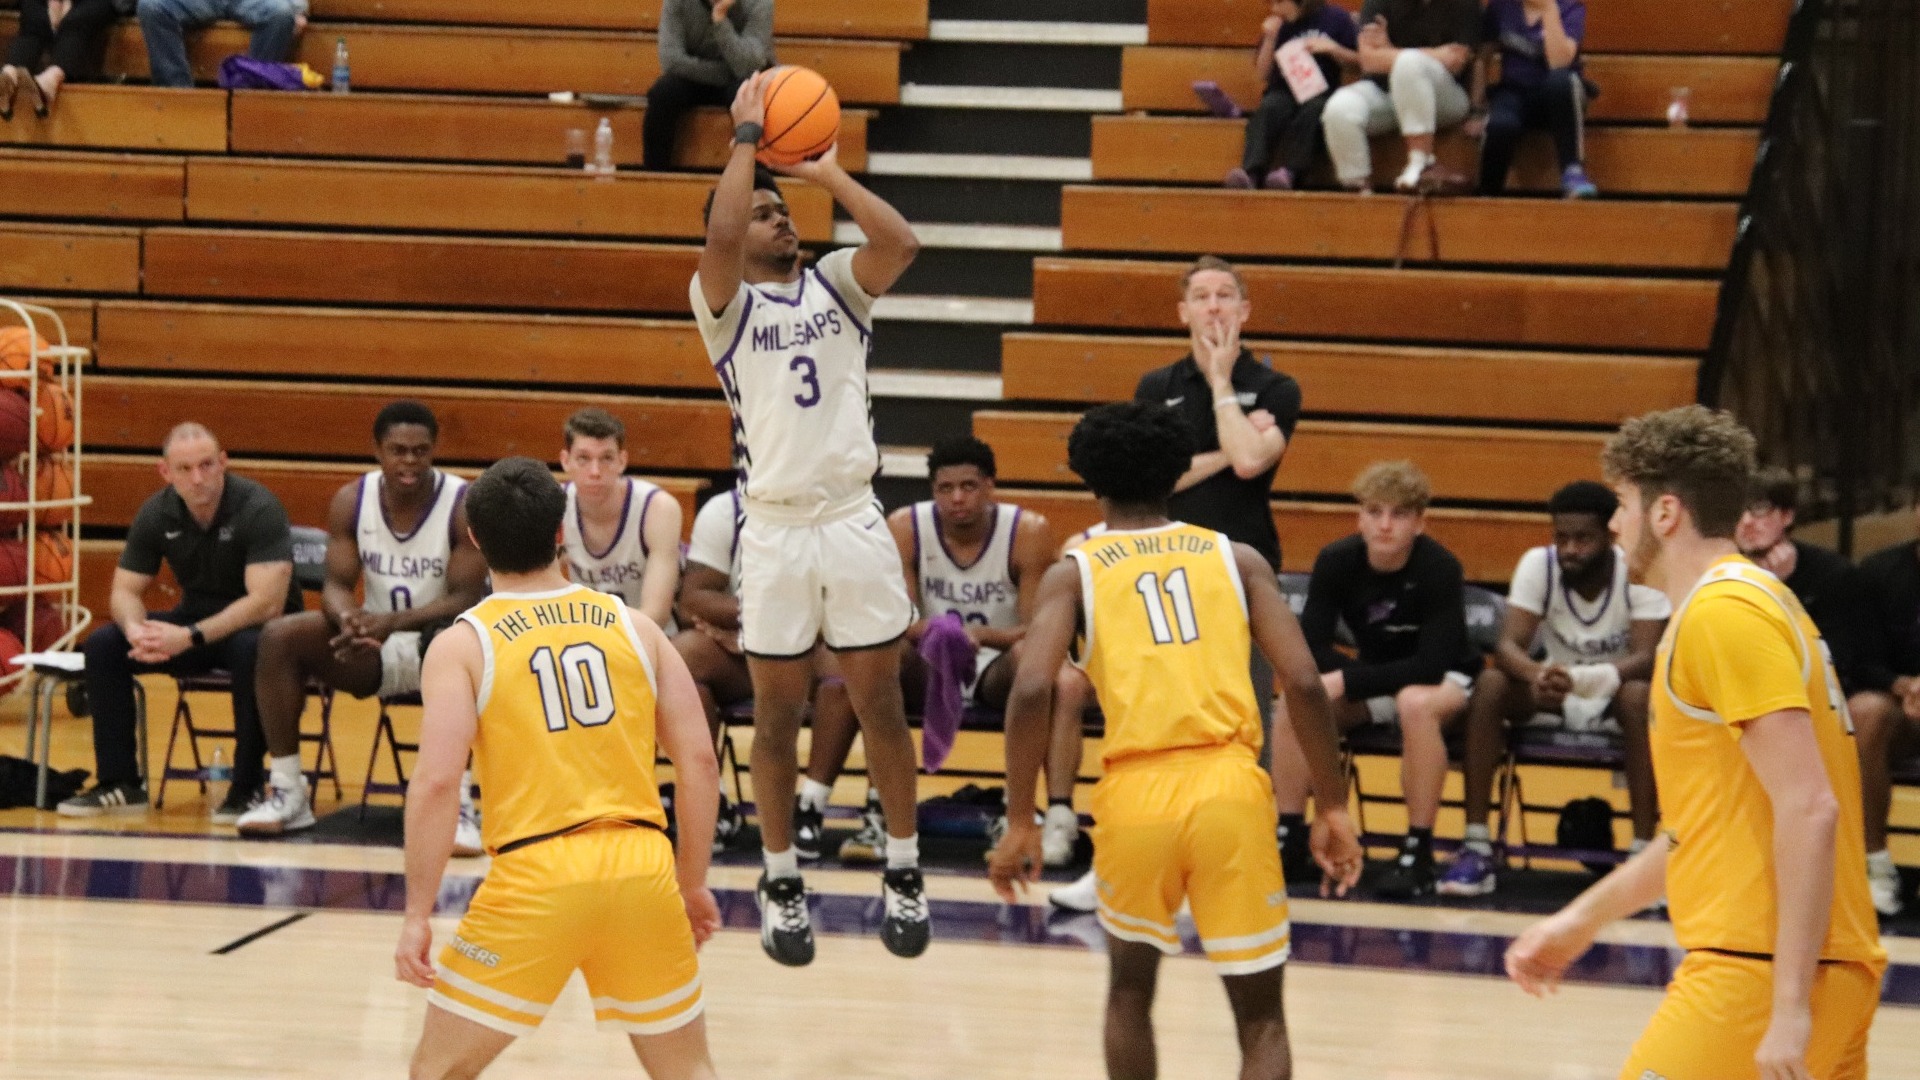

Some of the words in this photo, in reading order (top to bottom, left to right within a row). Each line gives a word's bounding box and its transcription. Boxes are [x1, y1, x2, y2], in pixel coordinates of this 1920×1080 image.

[789, 355, 821, 408] 3
[362, 550, 444, 578] MILLSAPS
[1093, 541, 1130, 568] THE
[1134, 534, 1214, 554] HILLTOP
[493, 610, 532, 642] THE
[532, 602, 616, 629] HILLTOP
[1135, 567, 1199, 645] 11
[529, 641, 616, 733] 10
